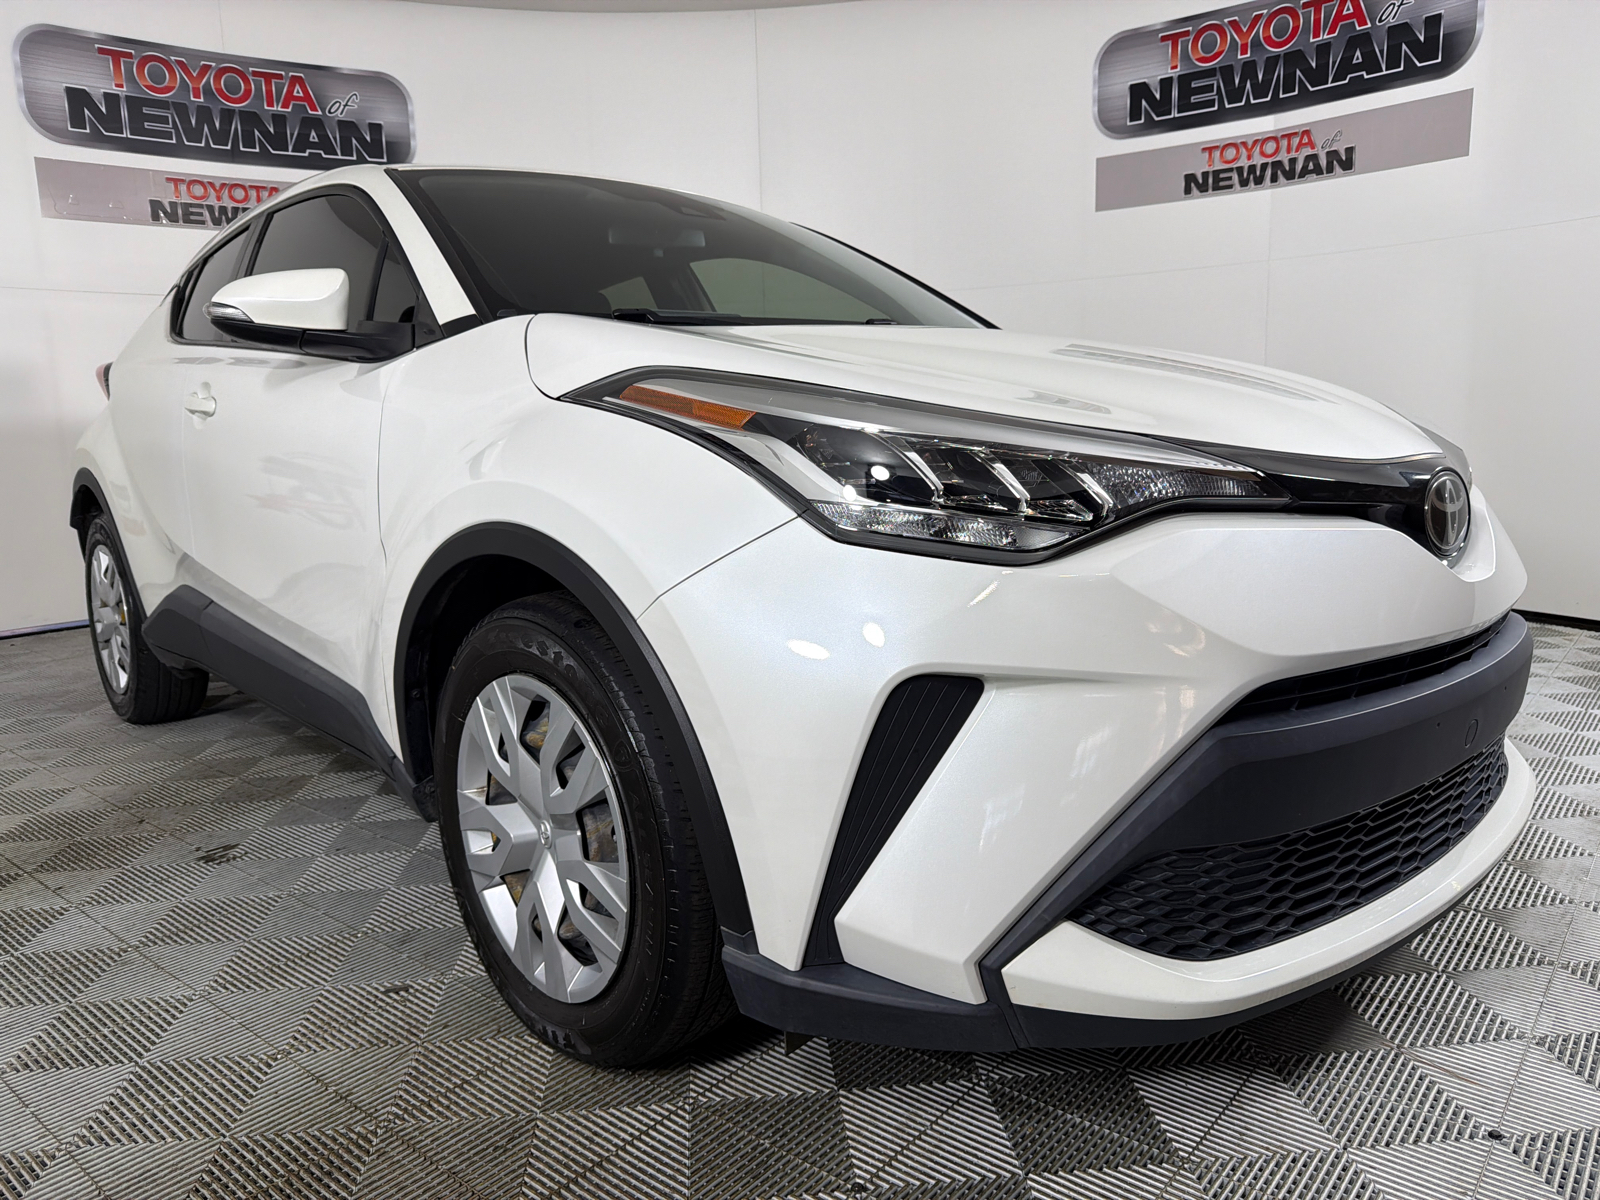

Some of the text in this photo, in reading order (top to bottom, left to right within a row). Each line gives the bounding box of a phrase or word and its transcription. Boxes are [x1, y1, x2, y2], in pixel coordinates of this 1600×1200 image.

[1127, 10, 1444, 126] NEWNAN
[1160, 0, 1414, 72] TOYOTA of
[95, 45, 358, 117] TOYOTA of
[64, 85, 388, 162] NEWNAN
[1201, 129, 1343, 168] TOYOTA of
[1183, 145, 1356, 196] NEWNAN
[148, 198, 251, 227] NEW
